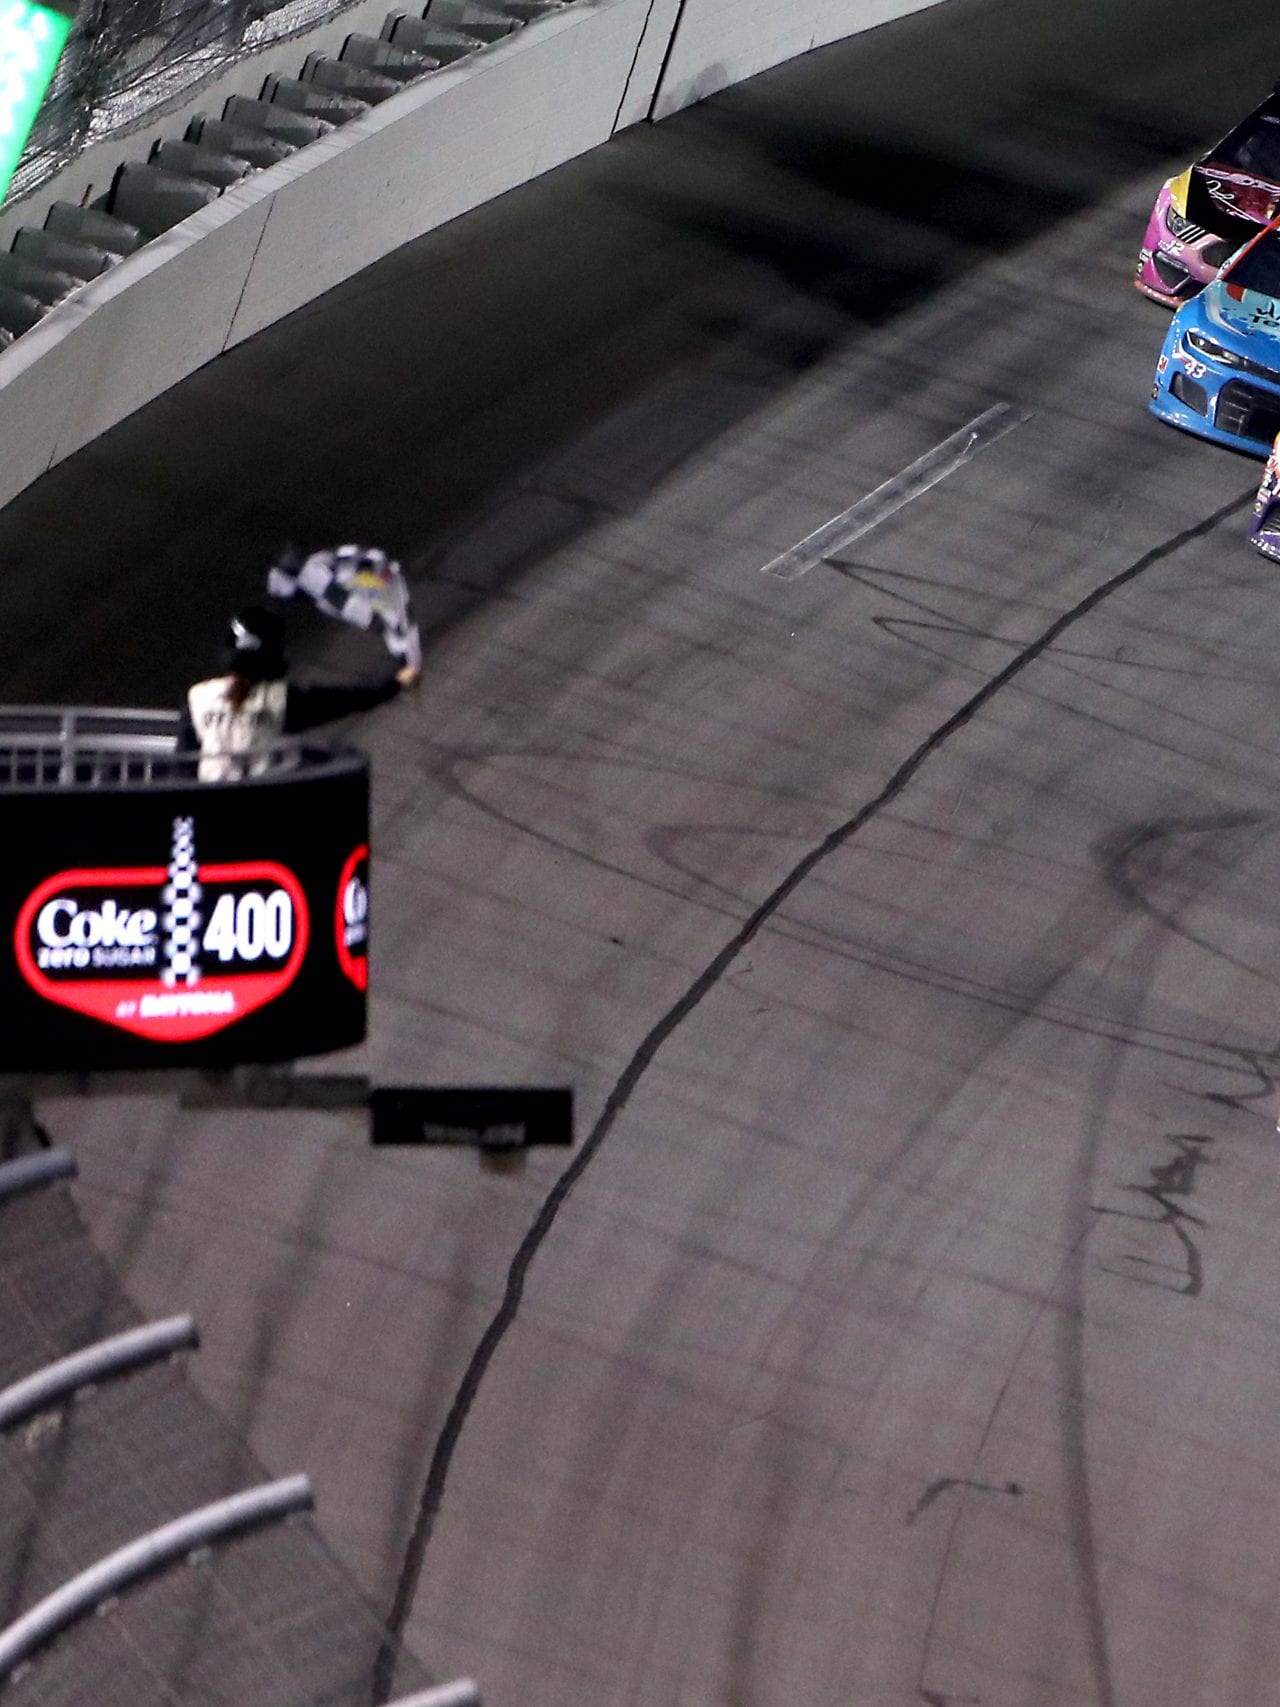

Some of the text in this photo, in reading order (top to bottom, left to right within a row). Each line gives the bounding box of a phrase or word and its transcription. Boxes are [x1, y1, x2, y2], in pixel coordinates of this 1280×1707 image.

[1185, 362, 1207, 378] 43
[37, 898, 158, 949] Coke
[202, 889, 292, 962] 400
